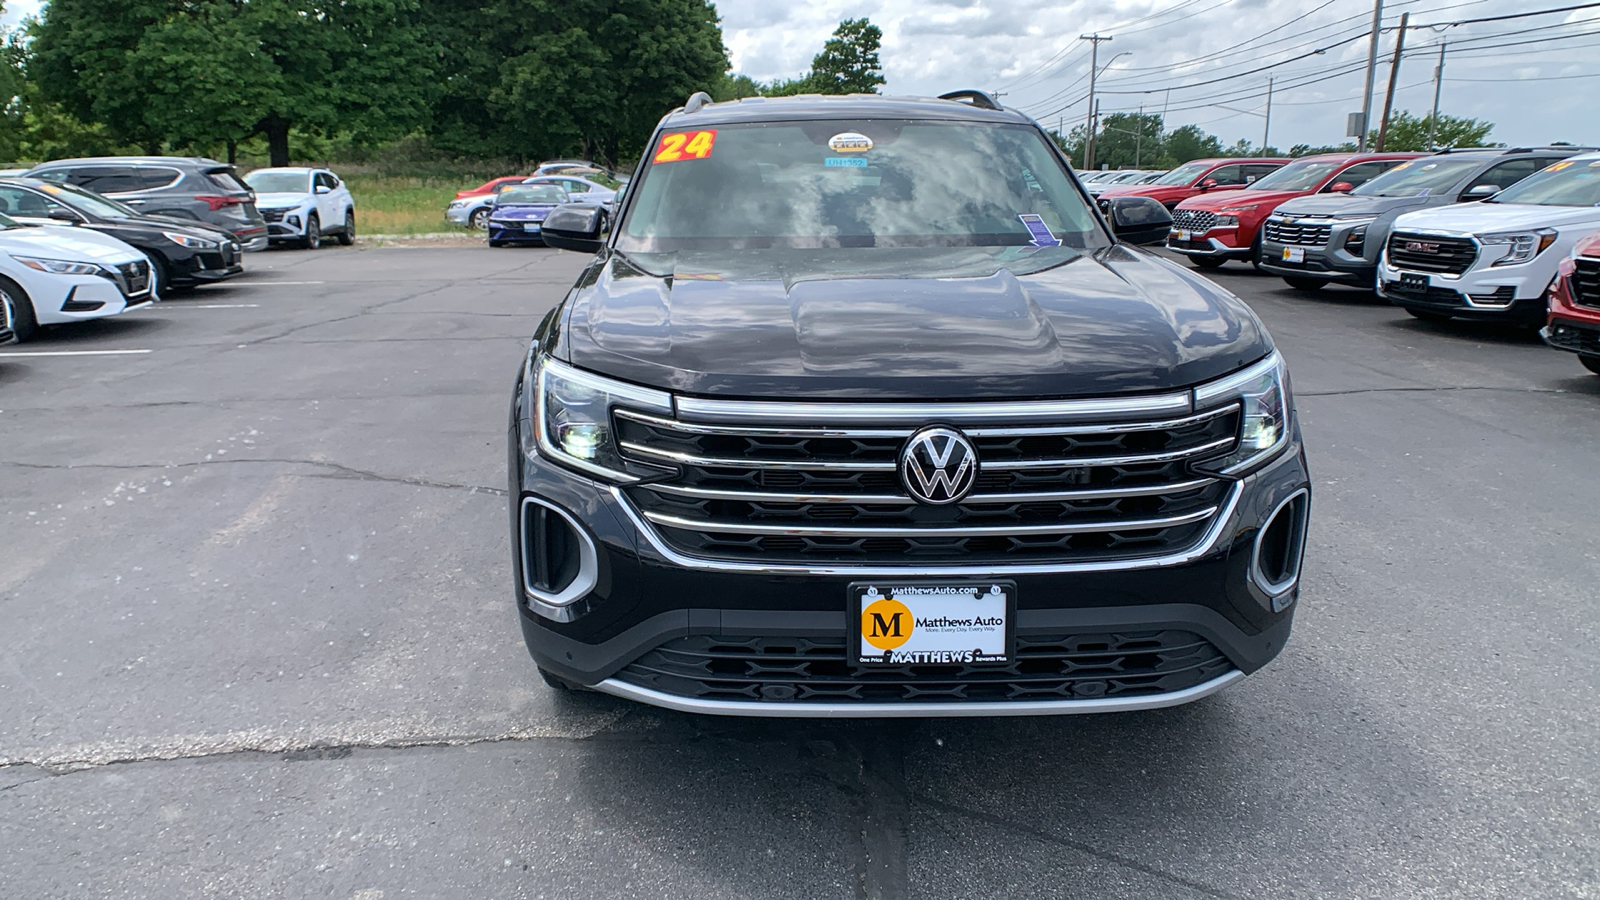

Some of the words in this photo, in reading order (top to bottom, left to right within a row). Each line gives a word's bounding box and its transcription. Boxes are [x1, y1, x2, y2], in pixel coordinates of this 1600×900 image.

[655, 131, 714, 162] 24
[905, 431, 974, 500] VW
[891, 586, 978, 595] MatthewsAuto.com
[869, 612, 904, 638] M
[915, 616, 972, 628] Matthews
[973, 615, 1003, 627] Auto
[889, 650, 973, 664] MATTHEWS
